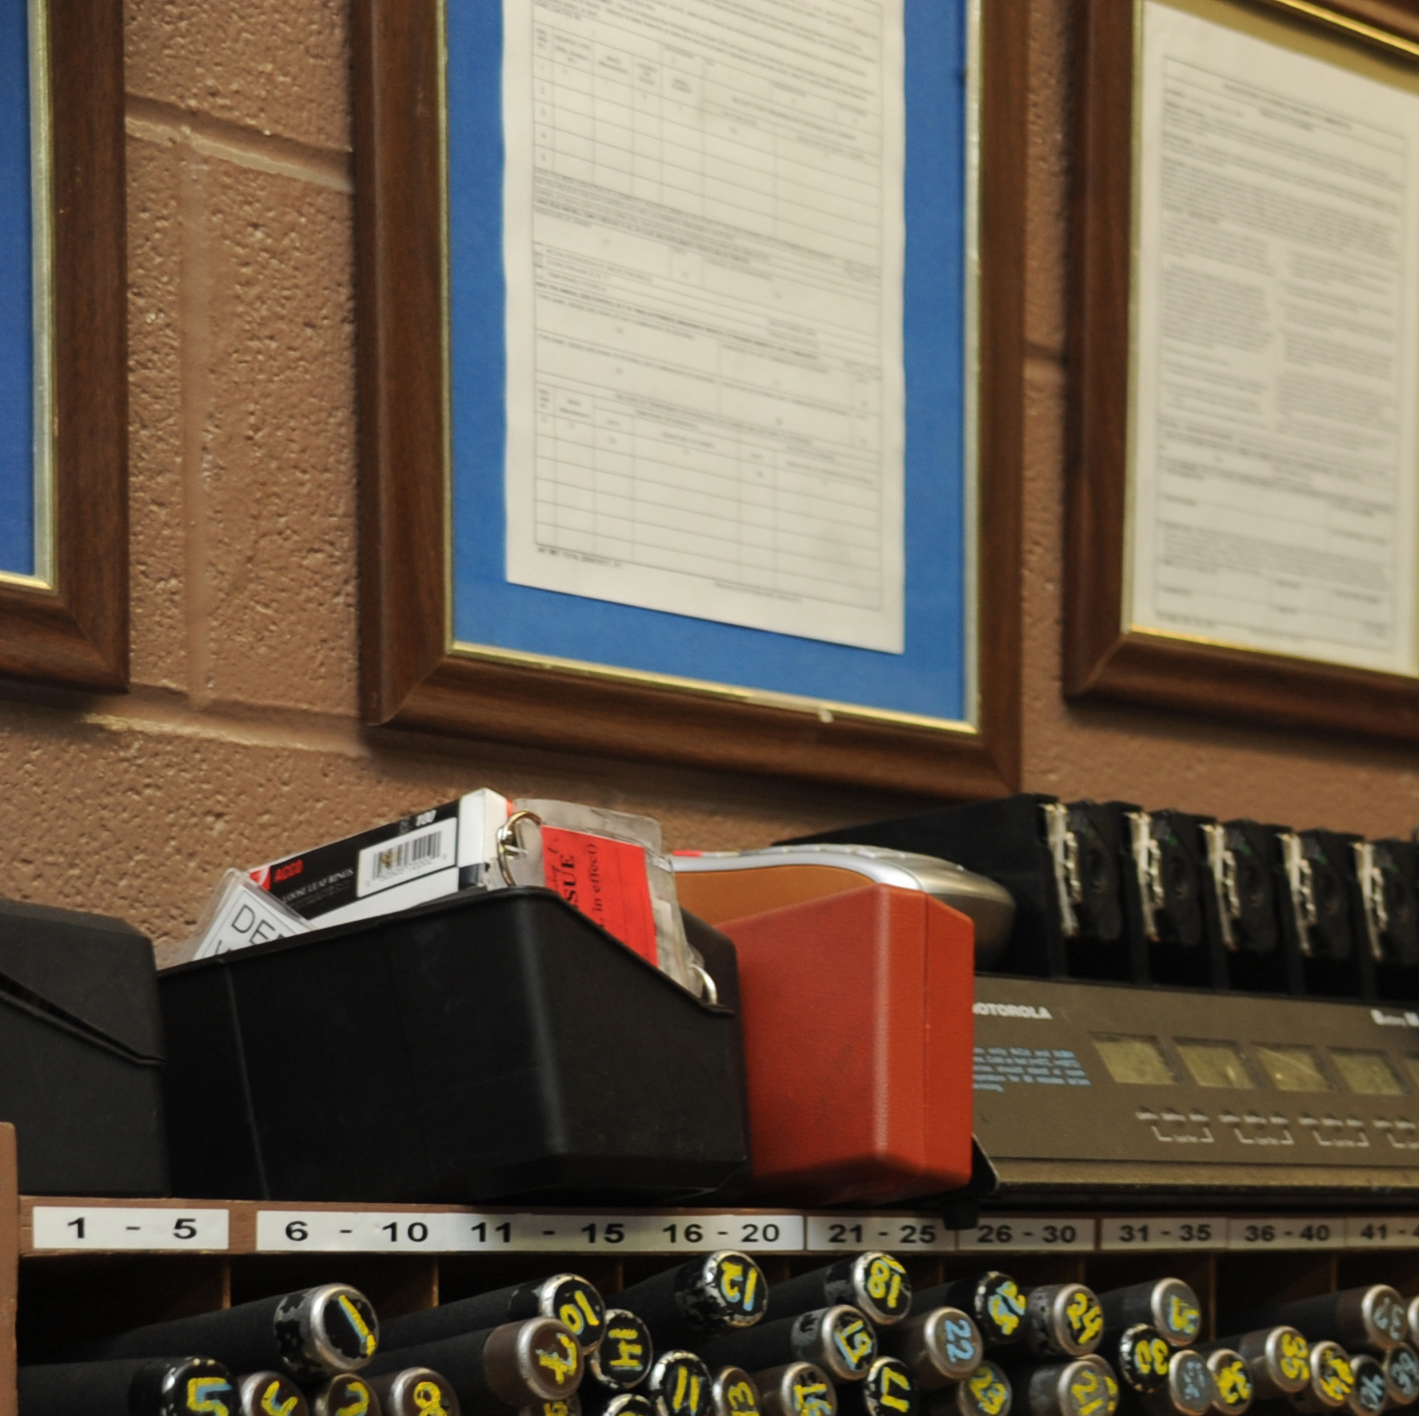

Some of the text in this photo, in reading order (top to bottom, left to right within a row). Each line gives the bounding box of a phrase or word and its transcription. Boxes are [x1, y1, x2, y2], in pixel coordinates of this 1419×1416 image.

[66, 1217, 86, 1239] 1
[172, 1217, 198, 1240] 5
[285, 1220, 309, 1242] 6
[381, 1221, 429, 1243] 10
[470, 1221, 512, 1243] 11
[580, 1222, 626, 1244] 15
[662, 1223, 704, 1244] 16
[740, 1223, 781, 1243] 20
[828, 1223, 863, 1243] 21
[900, 1224, 937, 1244] 25
[977, 1224, 1013, 1243] 26
[1042, 1225, 1077, 1244] 30
[1118, 1225, 1150, 1242] 31
[1179, 1224, 1212, 1242] 35
[1245, 1224, 1276, 1242] 36
[1300, 1224, 1331, 1241] 40
[1360, 1223, 1388, 1239] 41
[720, 1260, 757, 1311] 12
[559, 1289, 600, 1335] 10
[945, 1319, 975, 1363] 22
